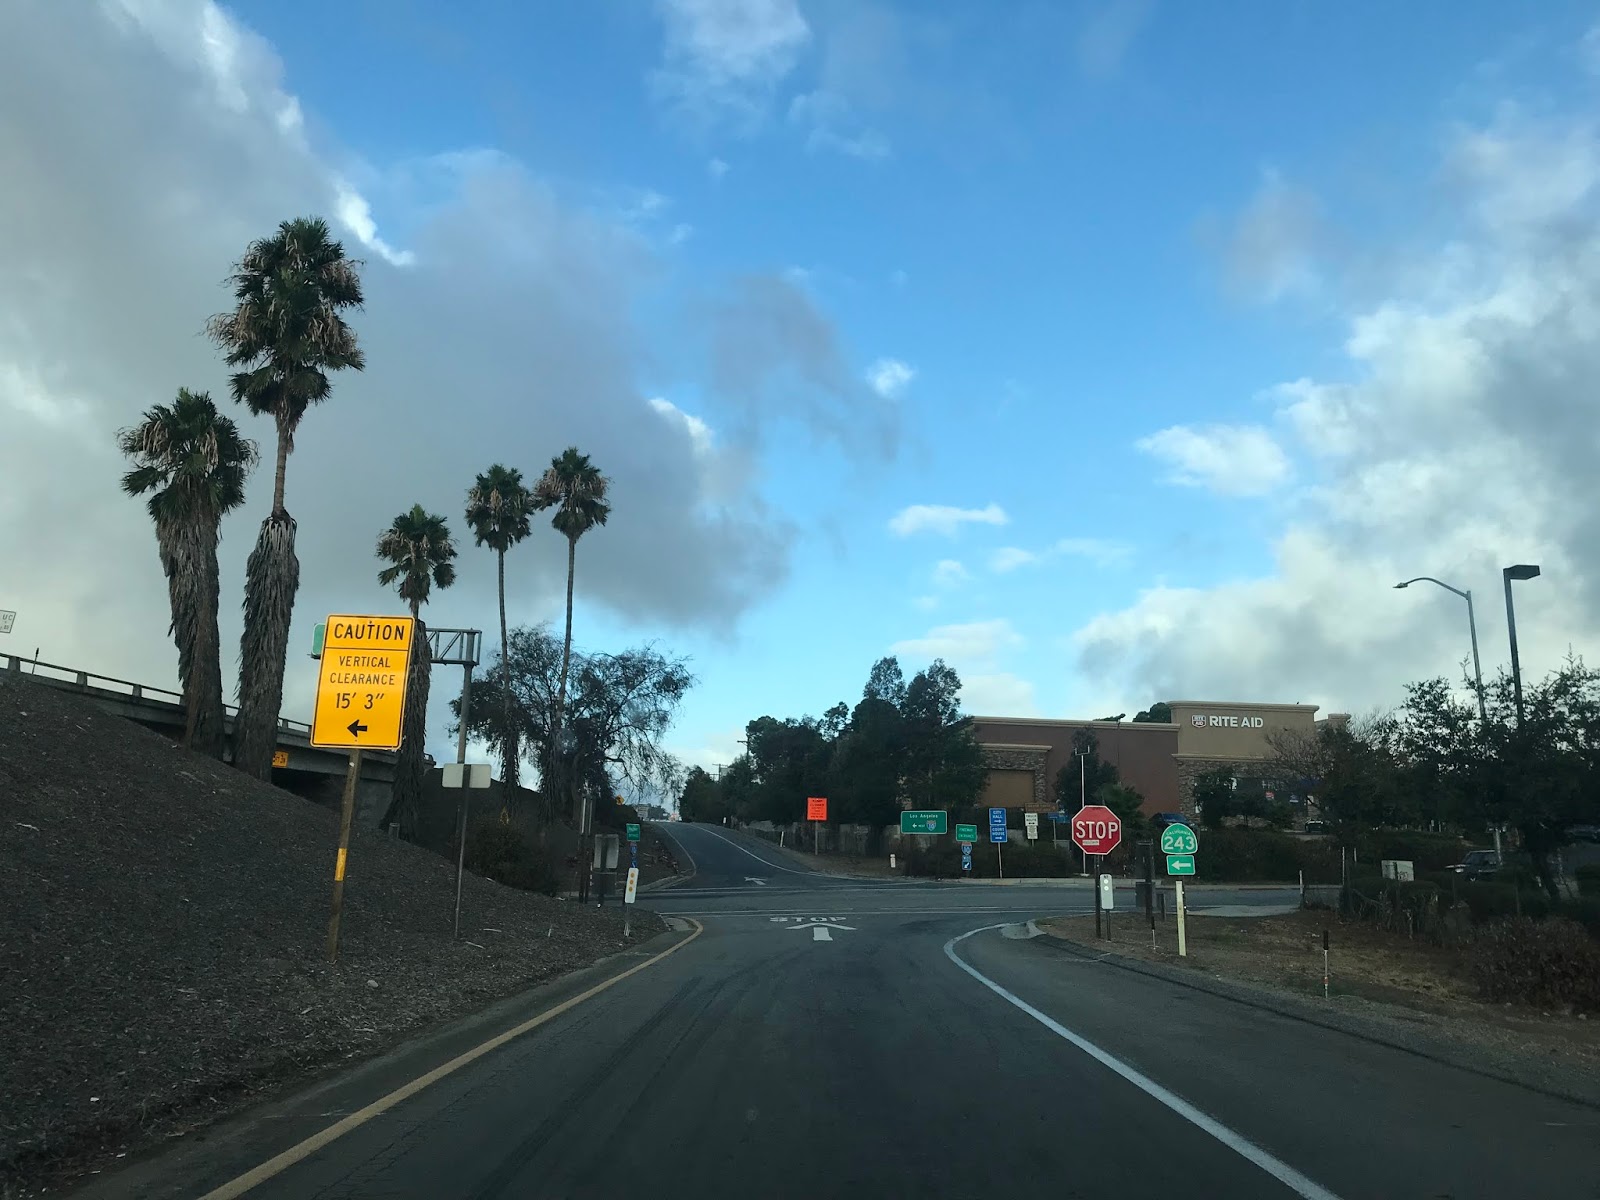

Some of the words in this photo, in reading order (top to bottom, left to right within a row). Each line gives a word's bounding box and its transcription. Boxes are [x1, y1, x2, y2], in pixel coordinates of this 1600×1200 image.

[334, 624, 404, 640] CAUTION
[339, 656, 390, 668] VERTICAL
[330, 672, 396, 686] CLEARANCE
[336, 692, 356, 709] 15'
[1209, 716, 1238, 727] RITE
[1241, 716, 1263, 728] AID
[1076, 821, 1118, 839] STOP
[1164, 836, 1195, 850] 243
